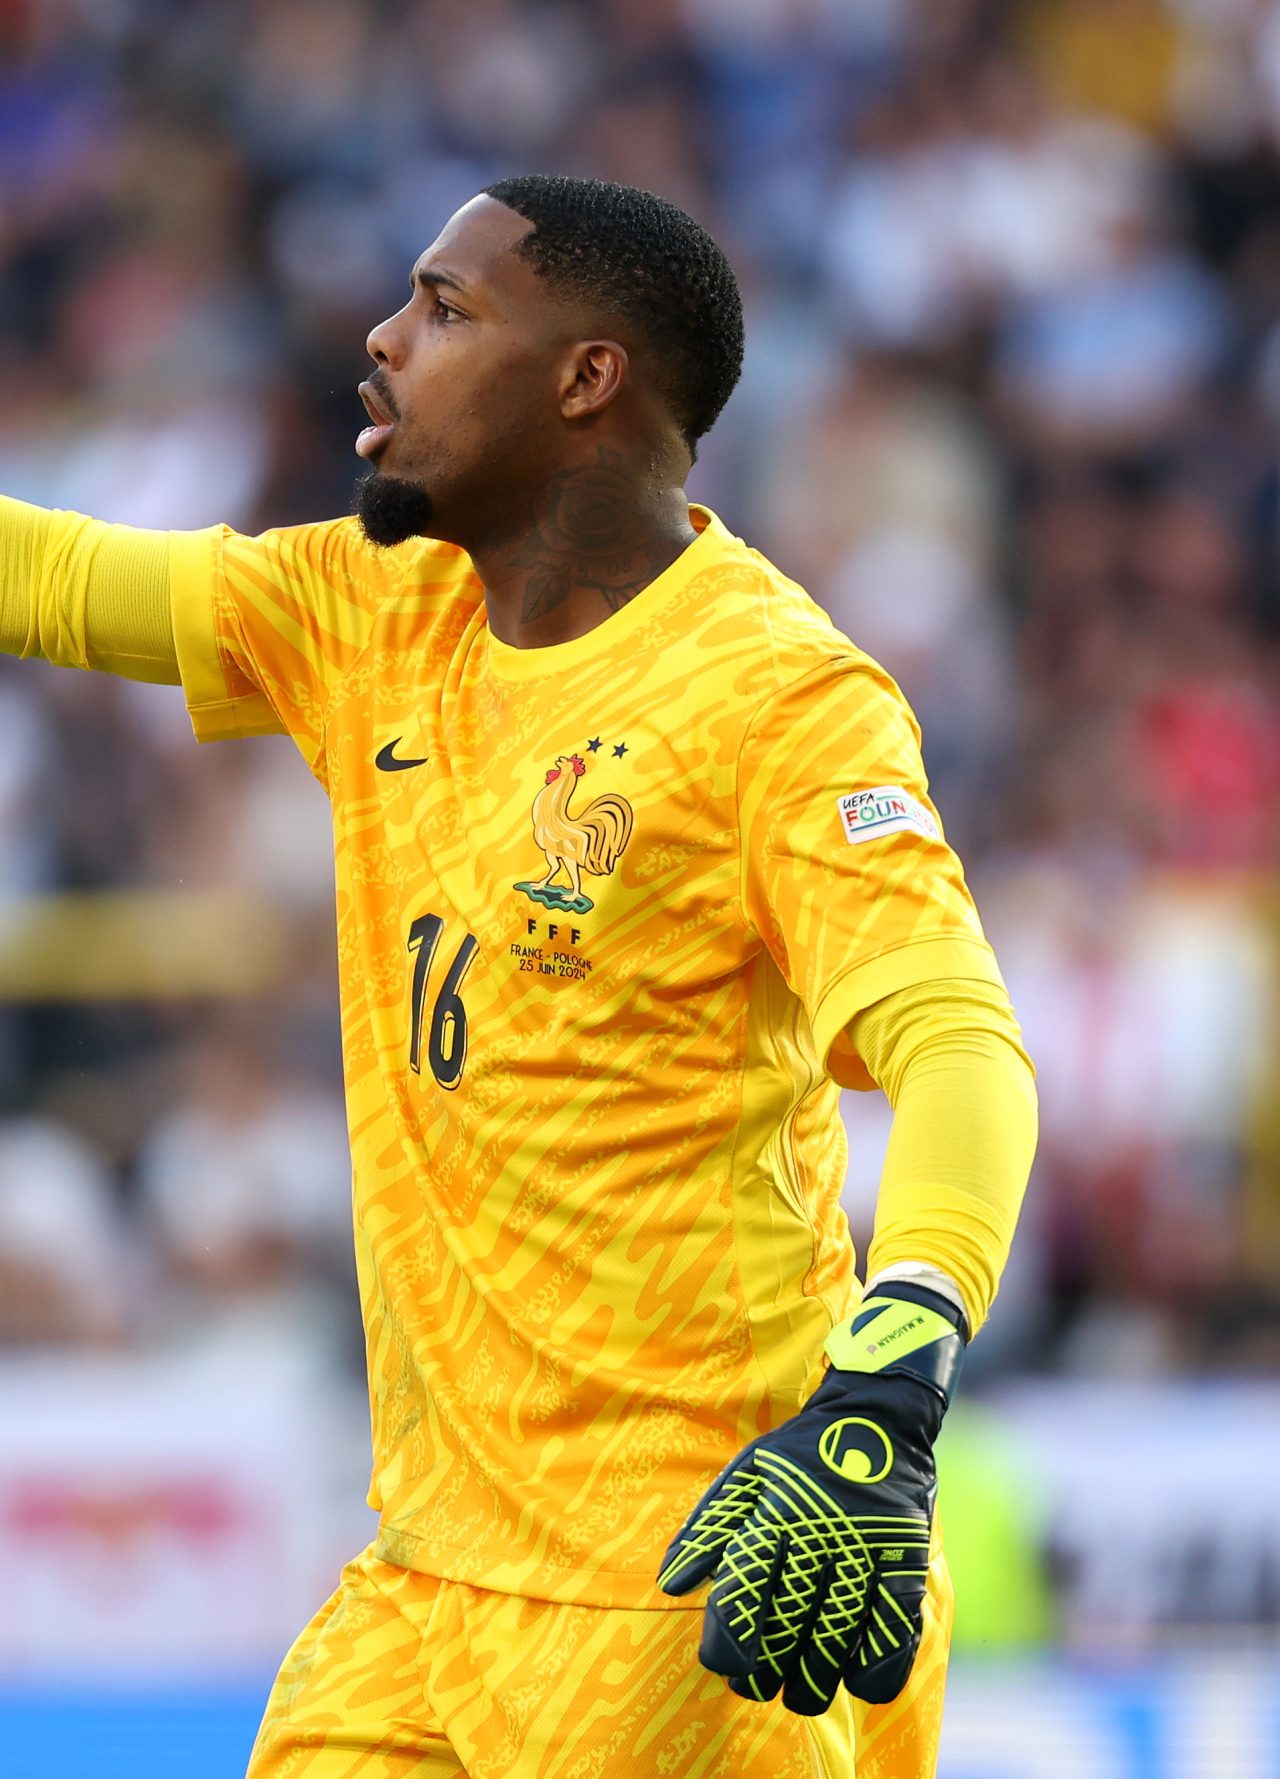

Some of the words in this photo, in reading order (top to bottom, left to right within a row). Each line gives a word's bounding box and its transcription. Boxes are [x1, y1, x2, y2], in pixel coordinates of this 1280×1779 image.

[843, 793, 875, 809] UEFA
[510, 943, 544, 961] FRANCE
[554, 951, 593, 971] POLOGNE
[519, 959, 534, 971] 25
[537, 962, 555, 975] JUIN
[558, 965, 587, 981] 2024
[407, 912, 480, 1091] 16
